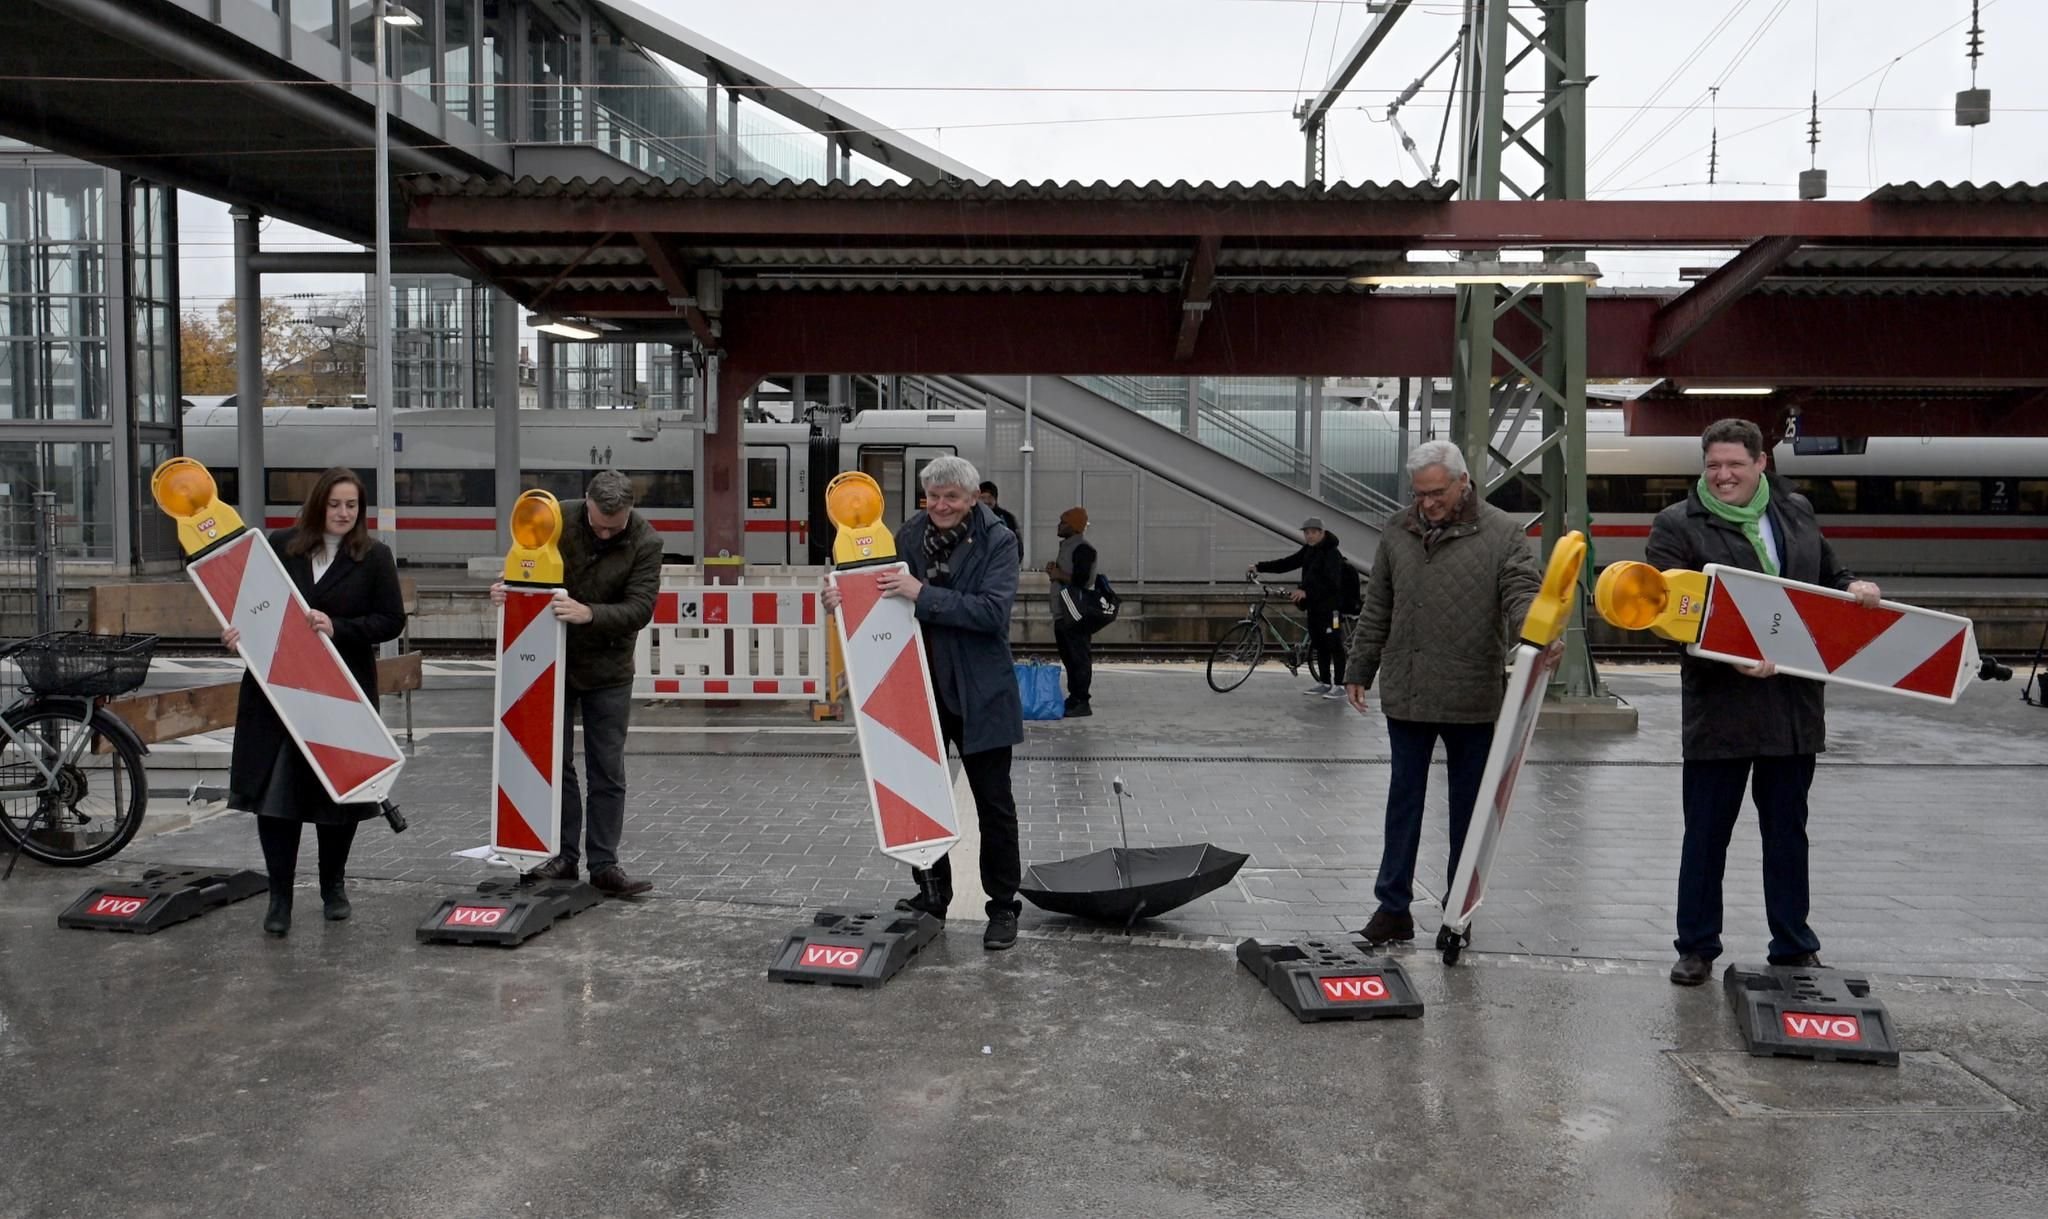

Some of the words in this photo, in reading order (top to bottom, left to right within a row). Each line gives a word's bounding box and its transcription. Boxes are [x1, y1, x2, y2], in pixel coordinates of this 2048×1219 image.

[1785, 417, 1796, 438] 25
[1995, 481, 2006, 496] 2
[198, 519, 215, 531] VVO
[856, 537, 872, 545] VVO
[250, 600, 270, 615] VVO
[1770, 613, 1781, 635] VVO
[872, 632, 892, 642] VVO
[520, 654, 536, 662] VVO
[96, 898, 141, 913] VVO
[455, 909, 500, 923] VVO
[808, 947, 858, 965] VVO
[1324, 980, 1384, 997] VVO
[1786, 1016, 1856, 1037] VVO
